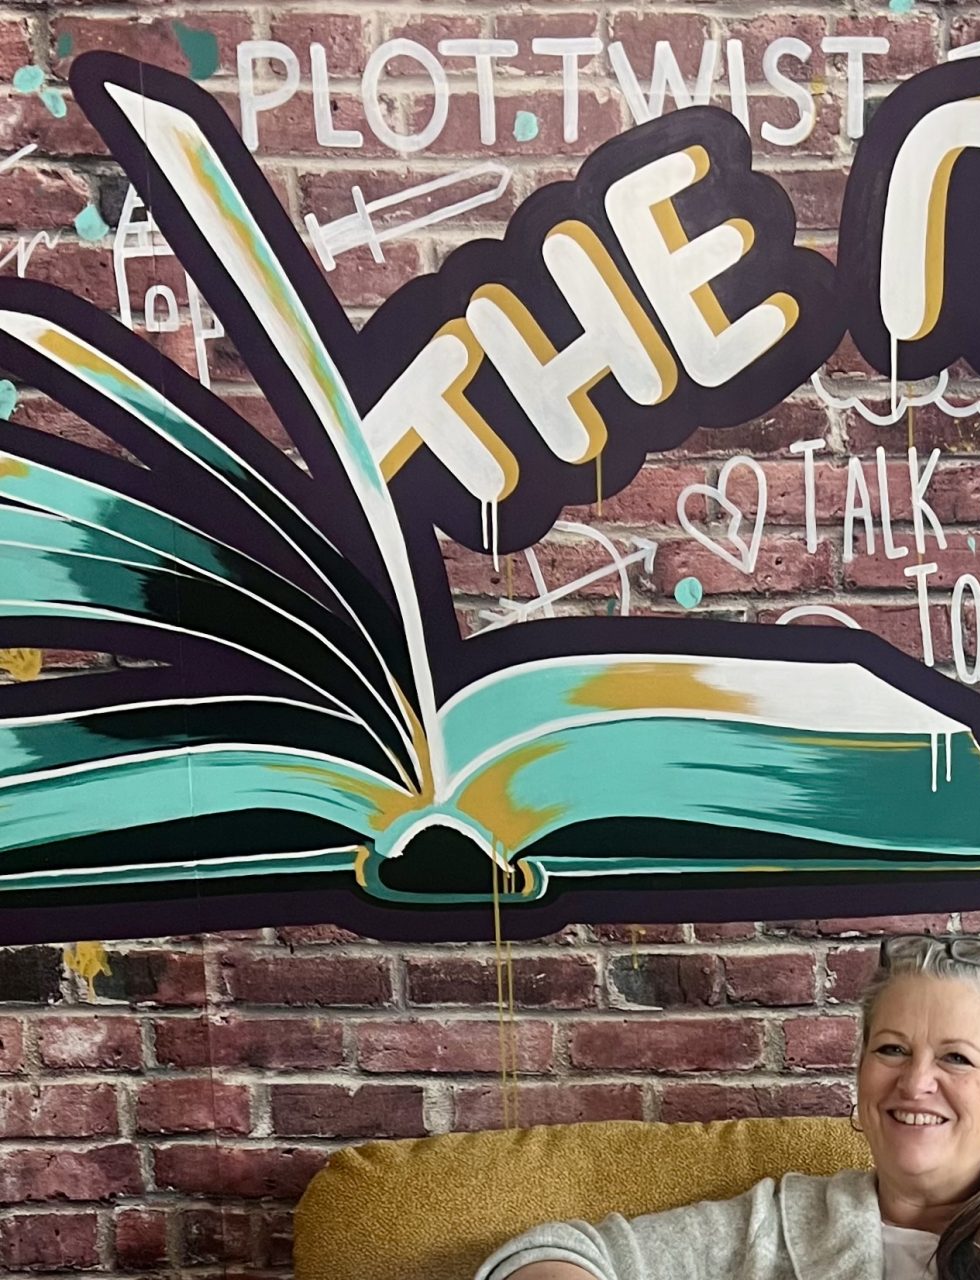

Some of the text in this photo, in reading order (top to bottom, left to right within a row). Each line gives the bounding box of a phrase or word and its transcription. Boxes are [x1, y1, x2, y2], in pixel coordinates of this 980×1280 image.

[237, 36, 890, 152] PLOT TWIST
[361, 145, 800, 502] THE
[790, 438, 948, 560] TALK
